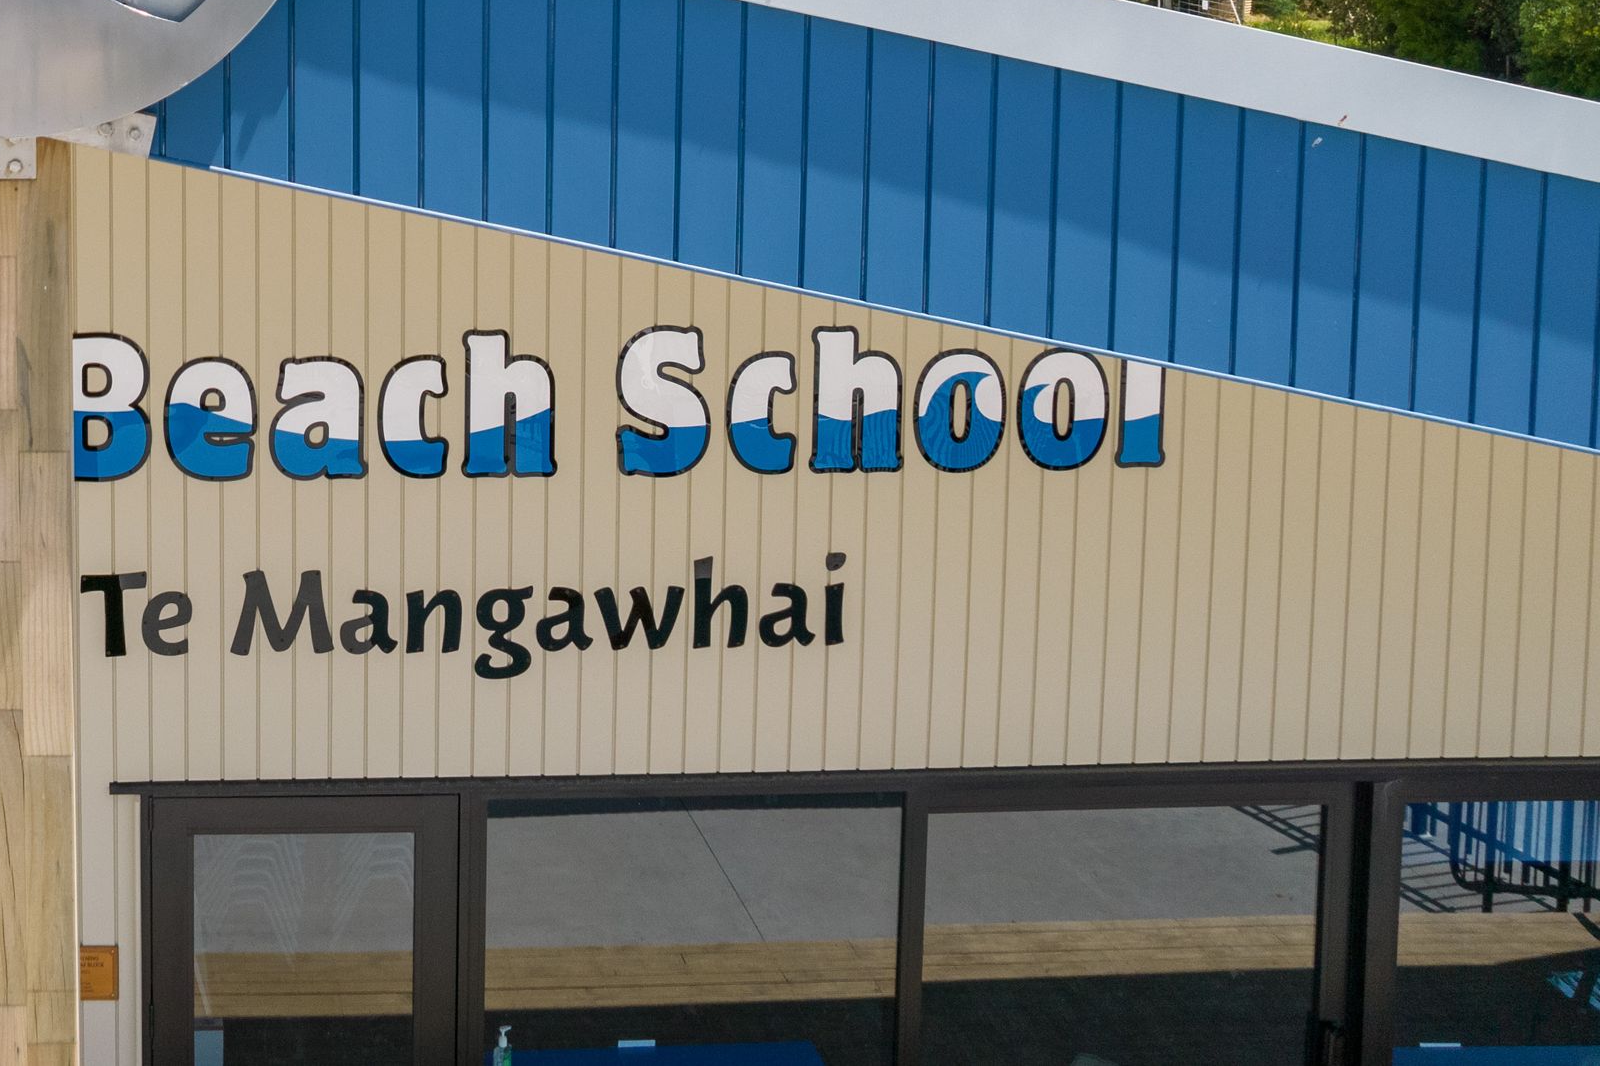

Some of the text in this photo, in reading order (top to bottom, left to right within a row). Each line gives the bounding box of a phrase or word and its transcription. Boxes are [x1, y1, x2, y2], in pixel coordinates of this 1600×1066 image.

[73, 328, 558, 482] Beach
[615, 324, 1166, 478] School
[80, 570, 193, 658] Te
[230, 551, 847, 680] Mangawhai
